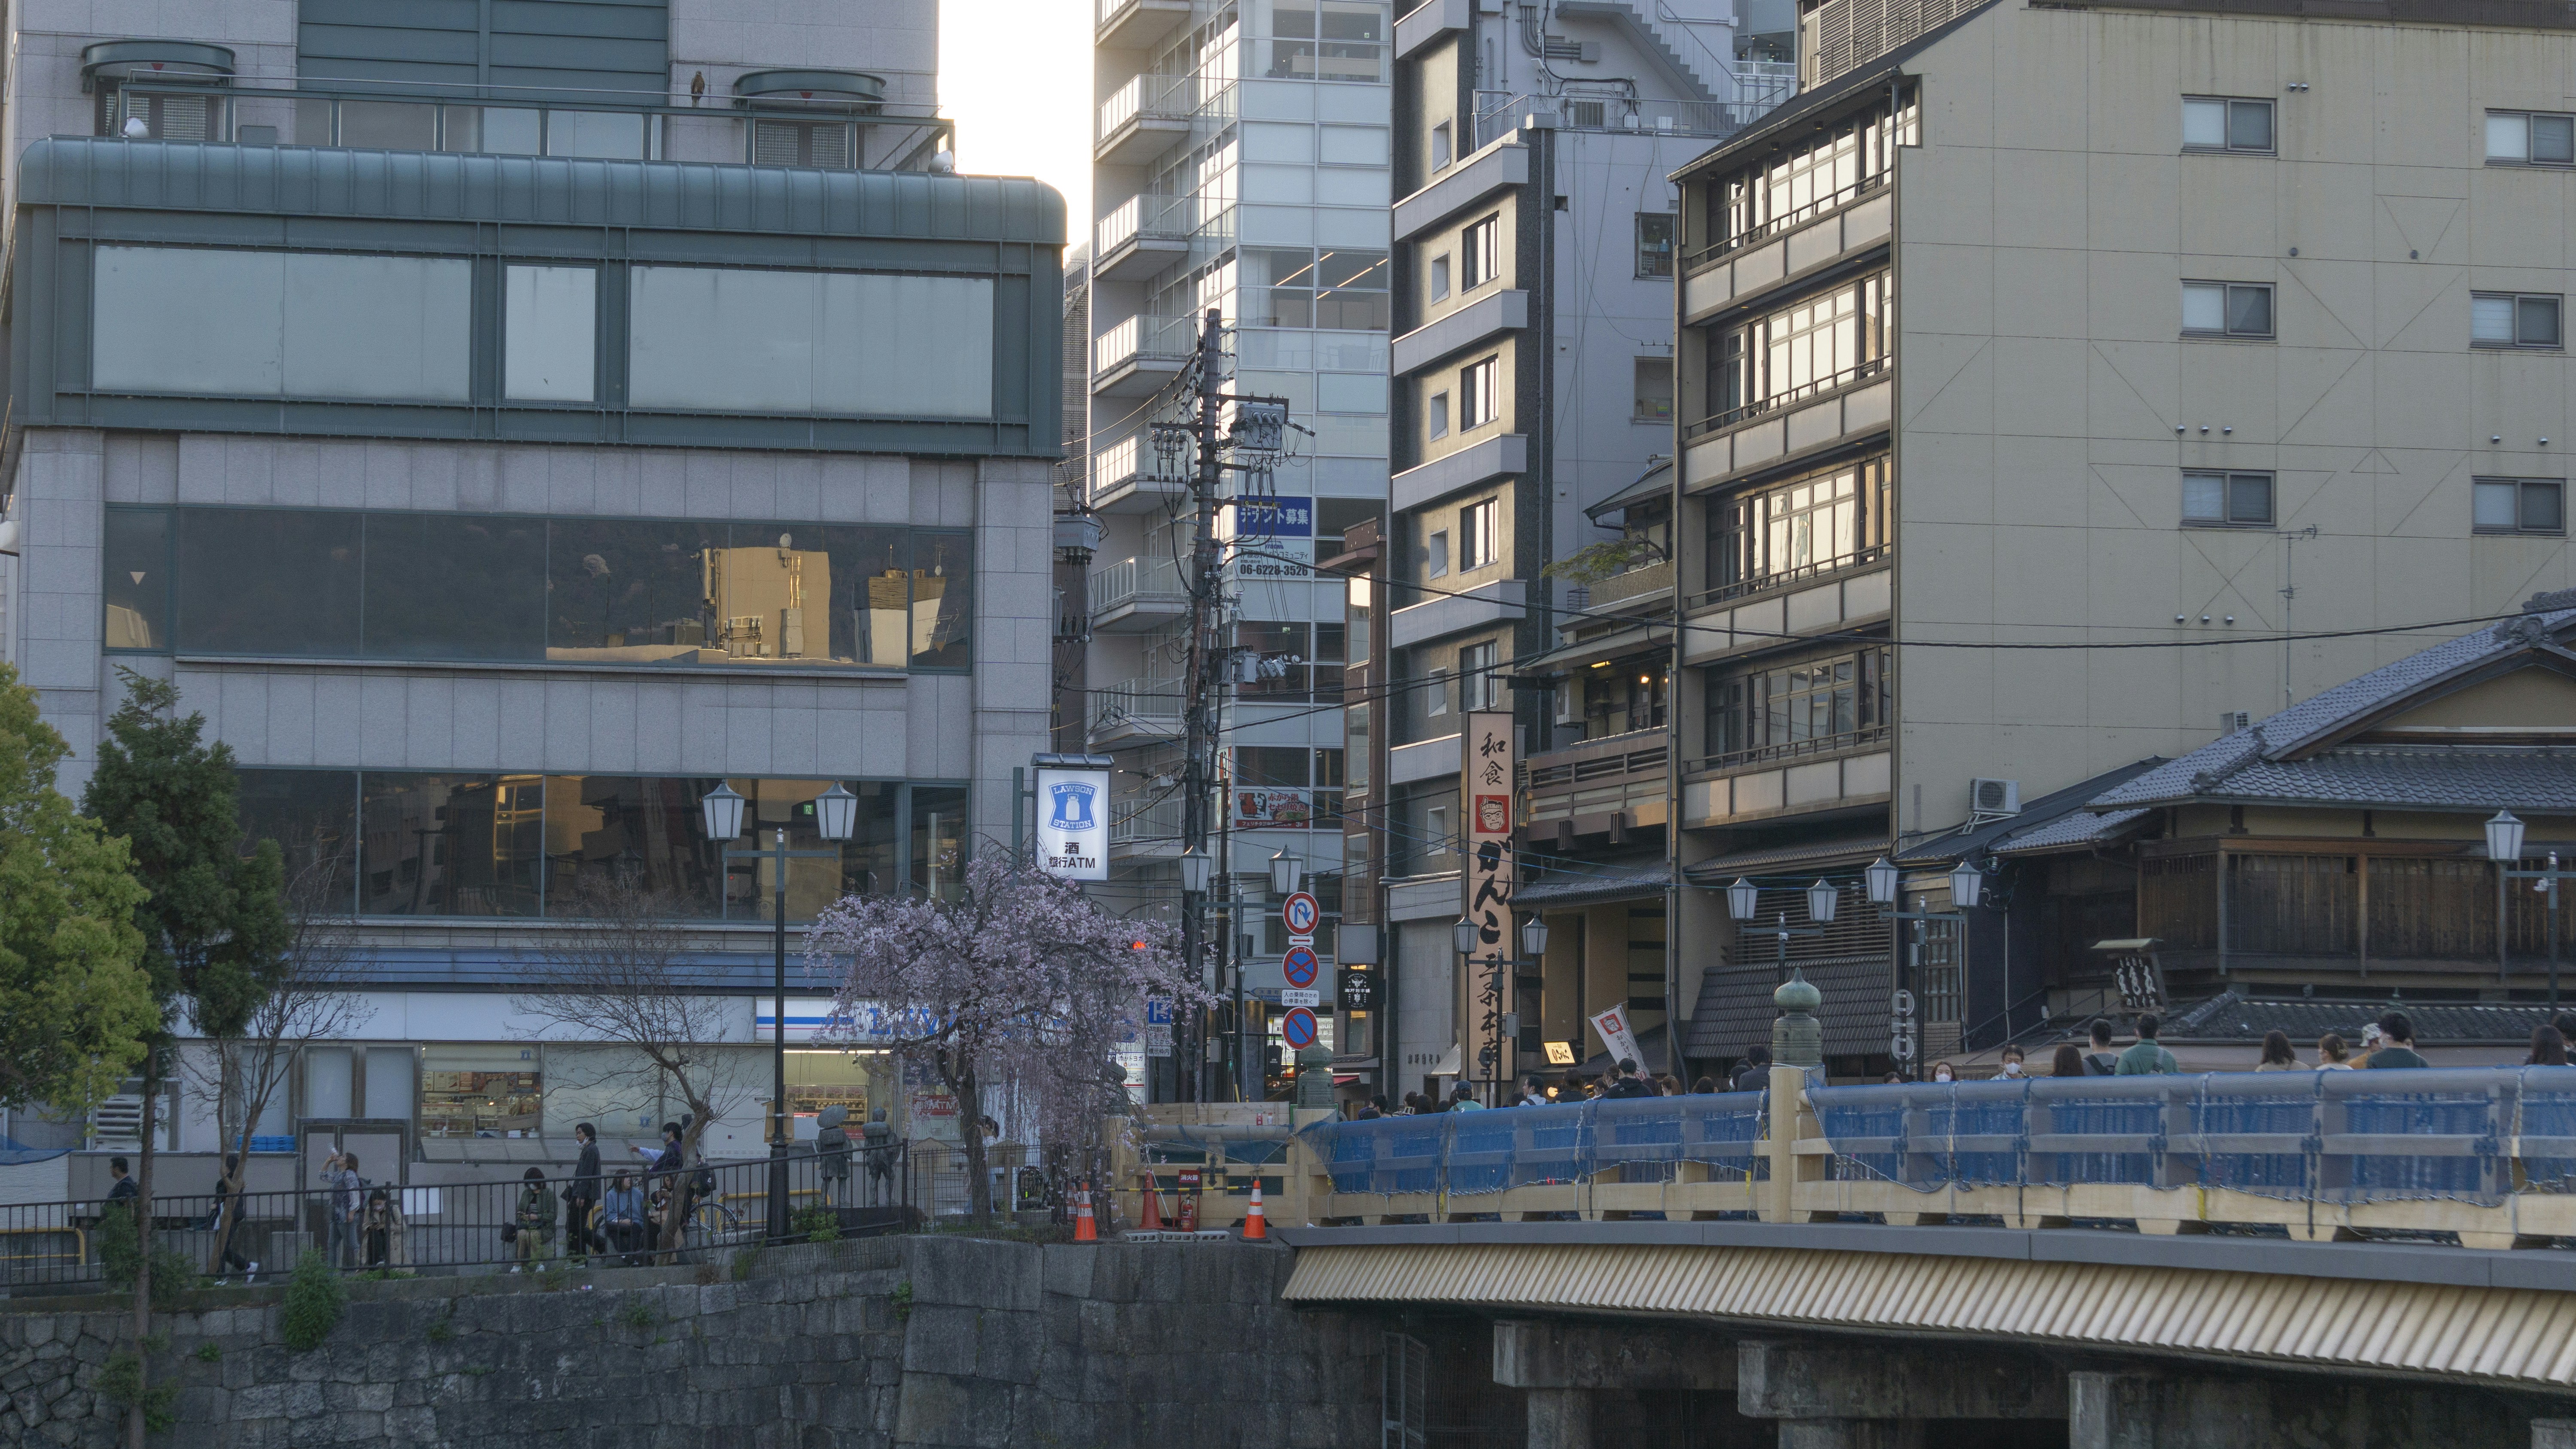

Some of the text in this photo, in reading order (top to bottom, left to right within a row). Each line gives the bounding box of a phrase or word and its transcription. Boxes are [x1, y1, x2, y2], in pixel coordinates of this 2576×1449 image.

[1240, 564, 1308, 576] 06-6228-3526
[1480, 732, 1507, 786] 和食
[1054, 786, 1093, 795] LAWSON
[1053, 820, 1091, 828] STATION
[1065, 842, 1079, 854] 酒
[1049, 857, 1095, 868] 銀行ATM
[1473, 834, 1514, 944] がんこ
